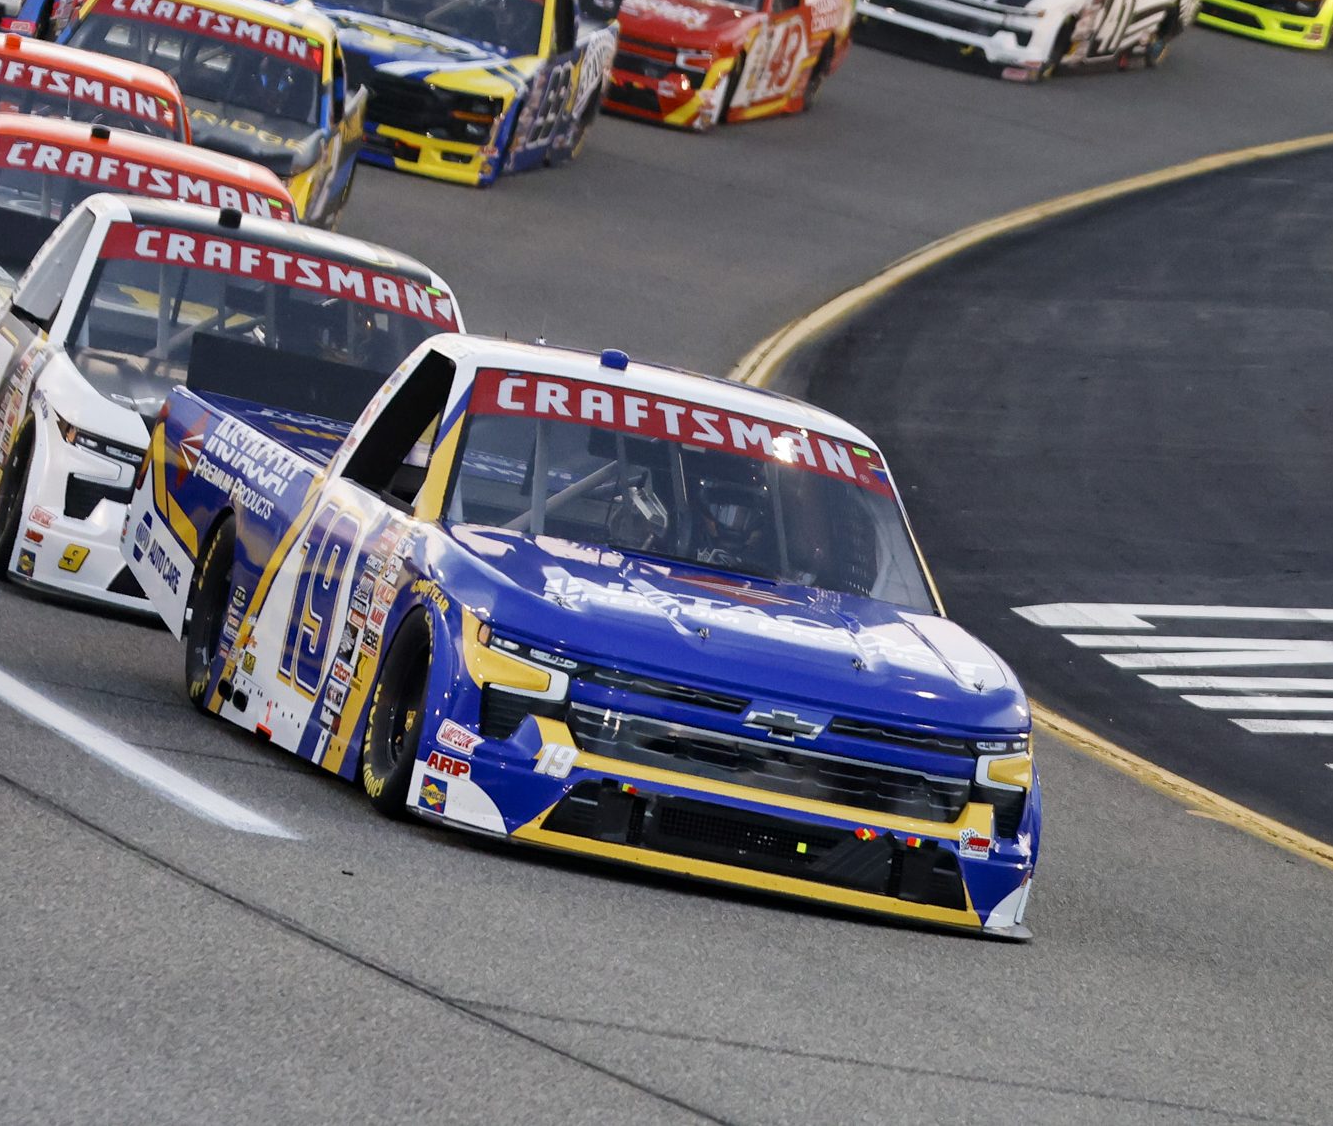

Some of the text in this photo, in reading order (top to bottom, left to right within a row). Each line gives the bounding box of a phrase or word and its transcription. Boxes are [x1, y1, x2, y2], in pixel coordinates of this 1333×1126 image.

[6, 140, 271, 218] CRAFTSMAN
[133, 229, 438, 320] CRAFTSMAN
[496, 376, 858, 481] CRAFTSMAN
[192, 452, 276, 522] PREMIUM PRODUCTS
[58, 543, 91, 573] 9
[278, 506, 363, 700] 19
[410, 578, 451, 612] GOODYEAR
[440, 722, 476, 749] SIMPSON
[426, 752, 470, 778] ARP
[533, 742, 579, 778] 19
[420, 785, 447, 803] SUNOCO
